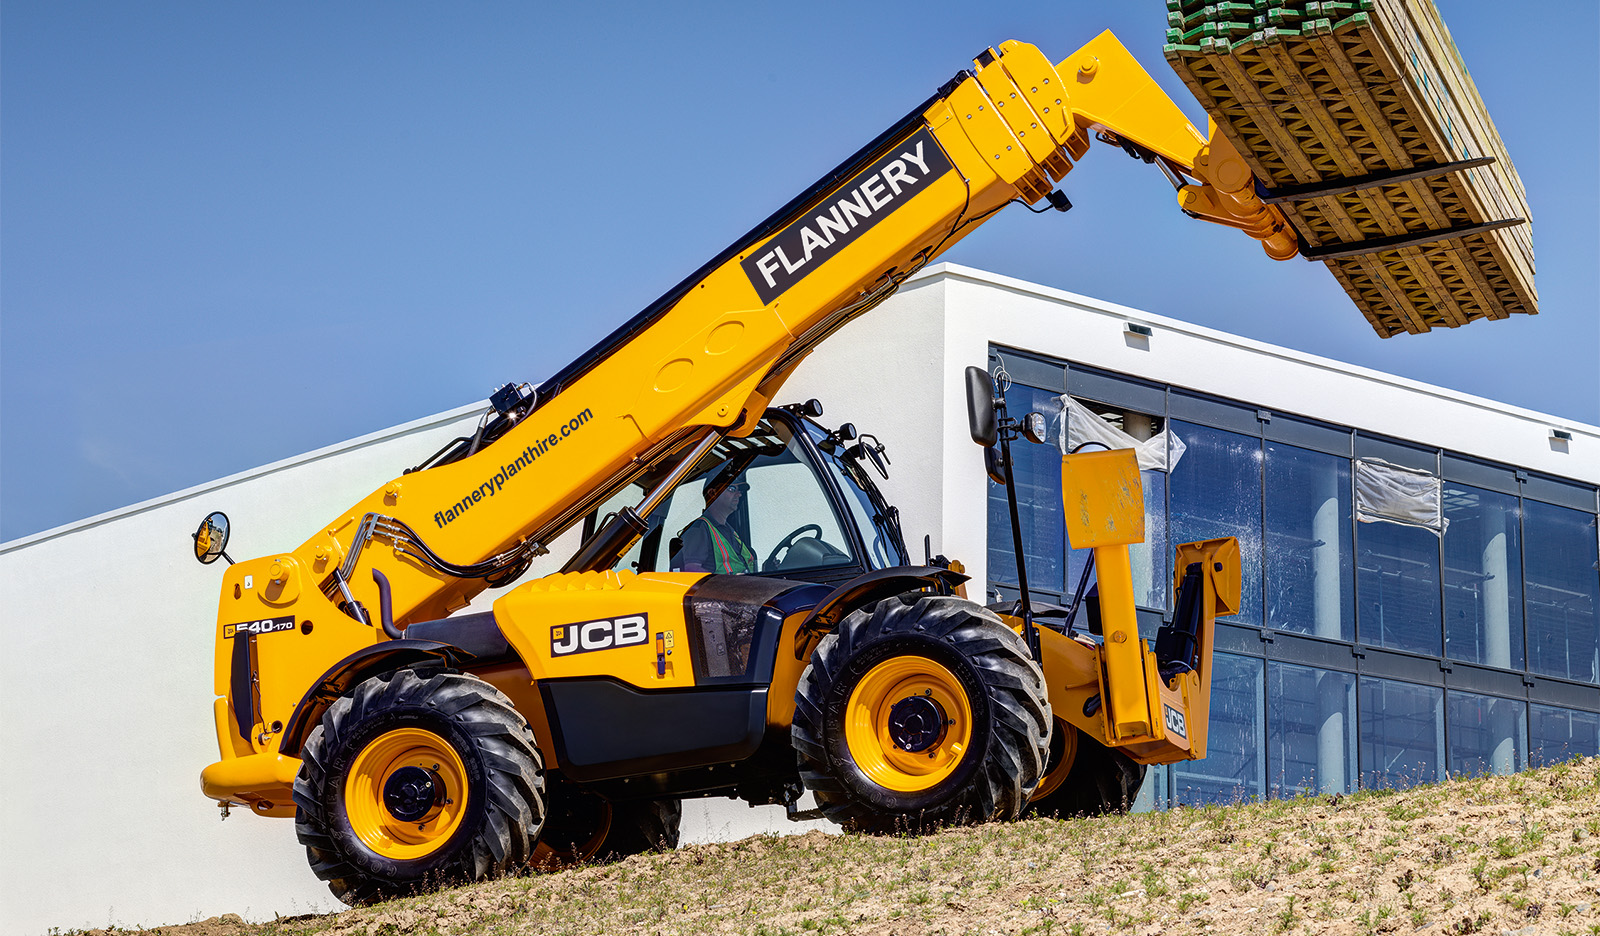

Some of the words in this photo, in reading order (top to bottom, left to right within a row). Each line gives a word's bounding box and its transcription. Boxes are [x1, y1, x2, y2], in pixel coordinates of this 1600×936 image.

[756, 140, 930, 288] FLANNERY
[434, 408, 594, 529] flanneryplanthire.com
[553, 616, 647, 654] JCB
[1166, 707, 1186, 737] JCB
